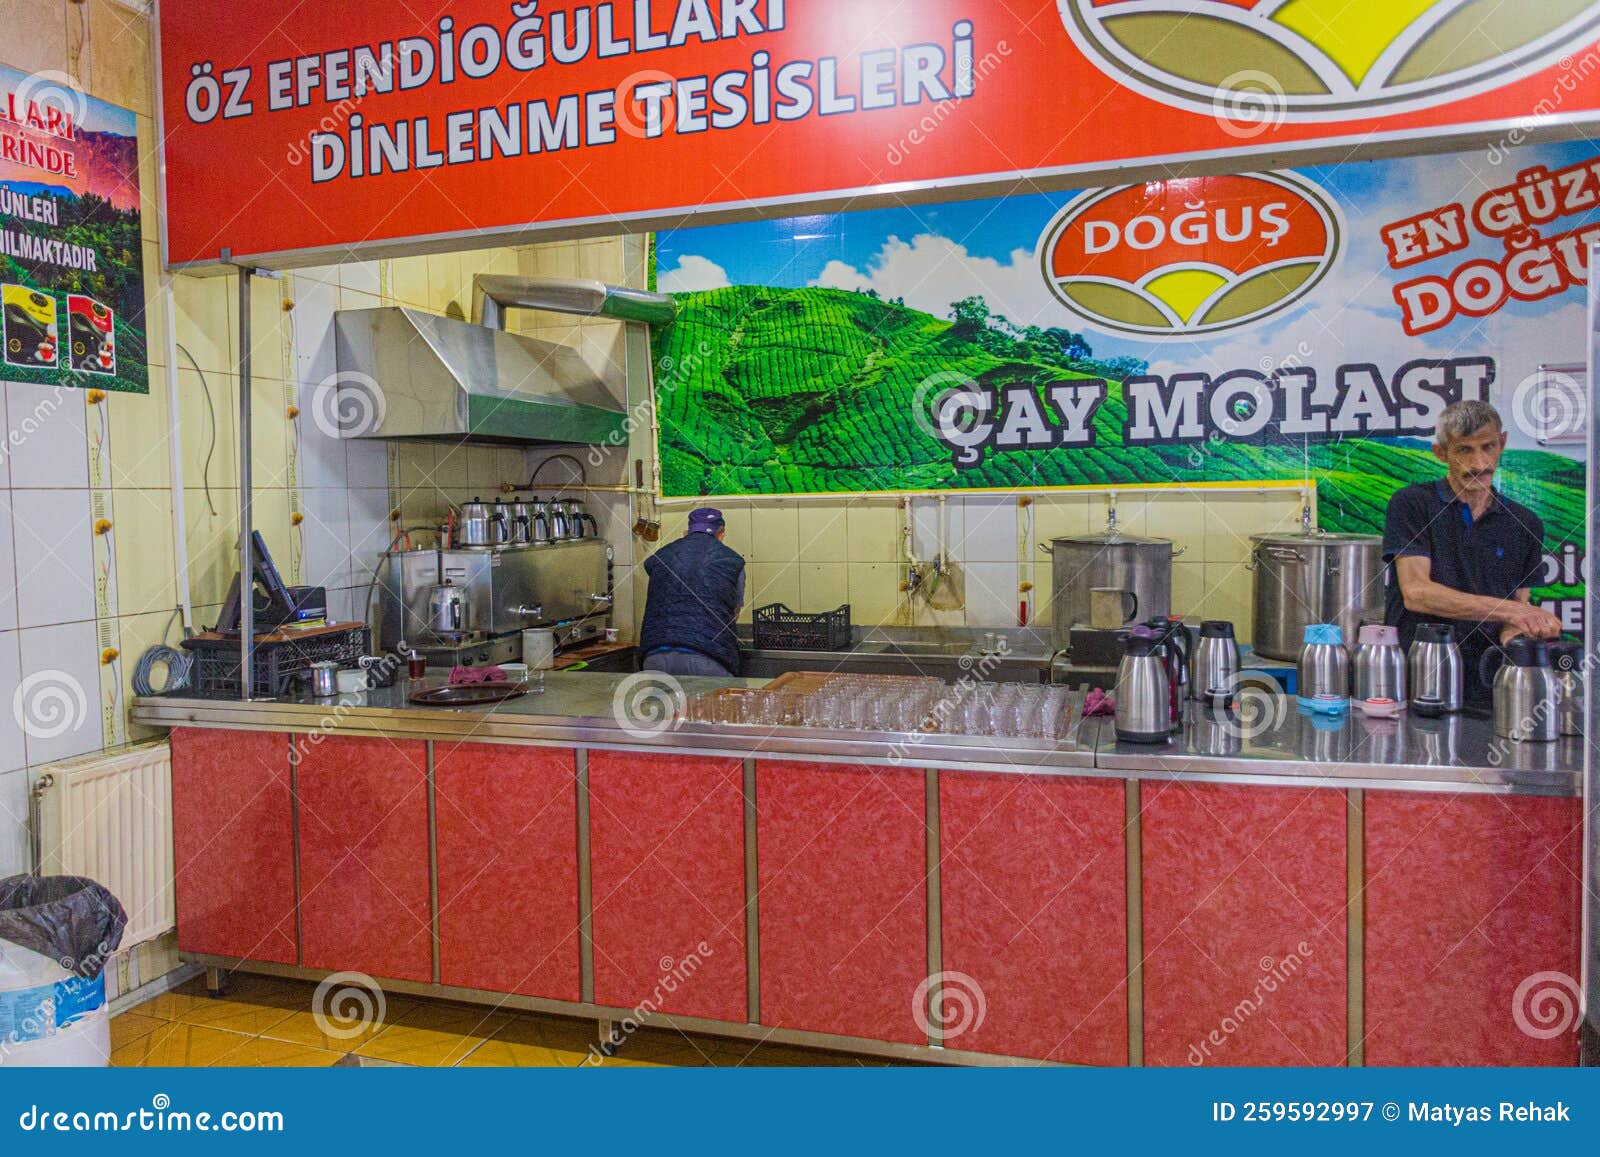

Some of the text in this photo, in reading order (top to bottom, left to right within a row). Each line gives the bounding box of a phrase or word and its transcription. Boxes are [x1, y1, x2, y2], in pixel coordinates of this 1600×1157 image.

[185, 0, 787, 125] ÖZ EFENDİOĞULLARI
[311, 20, 976, 184] DİNLENME TESİSLERİ
[0, 92, 76, 141] LARI
[1083, 201, 1291, 256] DOĞUŞ
[1387, 164, 1600, 262] EN GÜZ
[938, 384, 1100, 463] ÇAY
